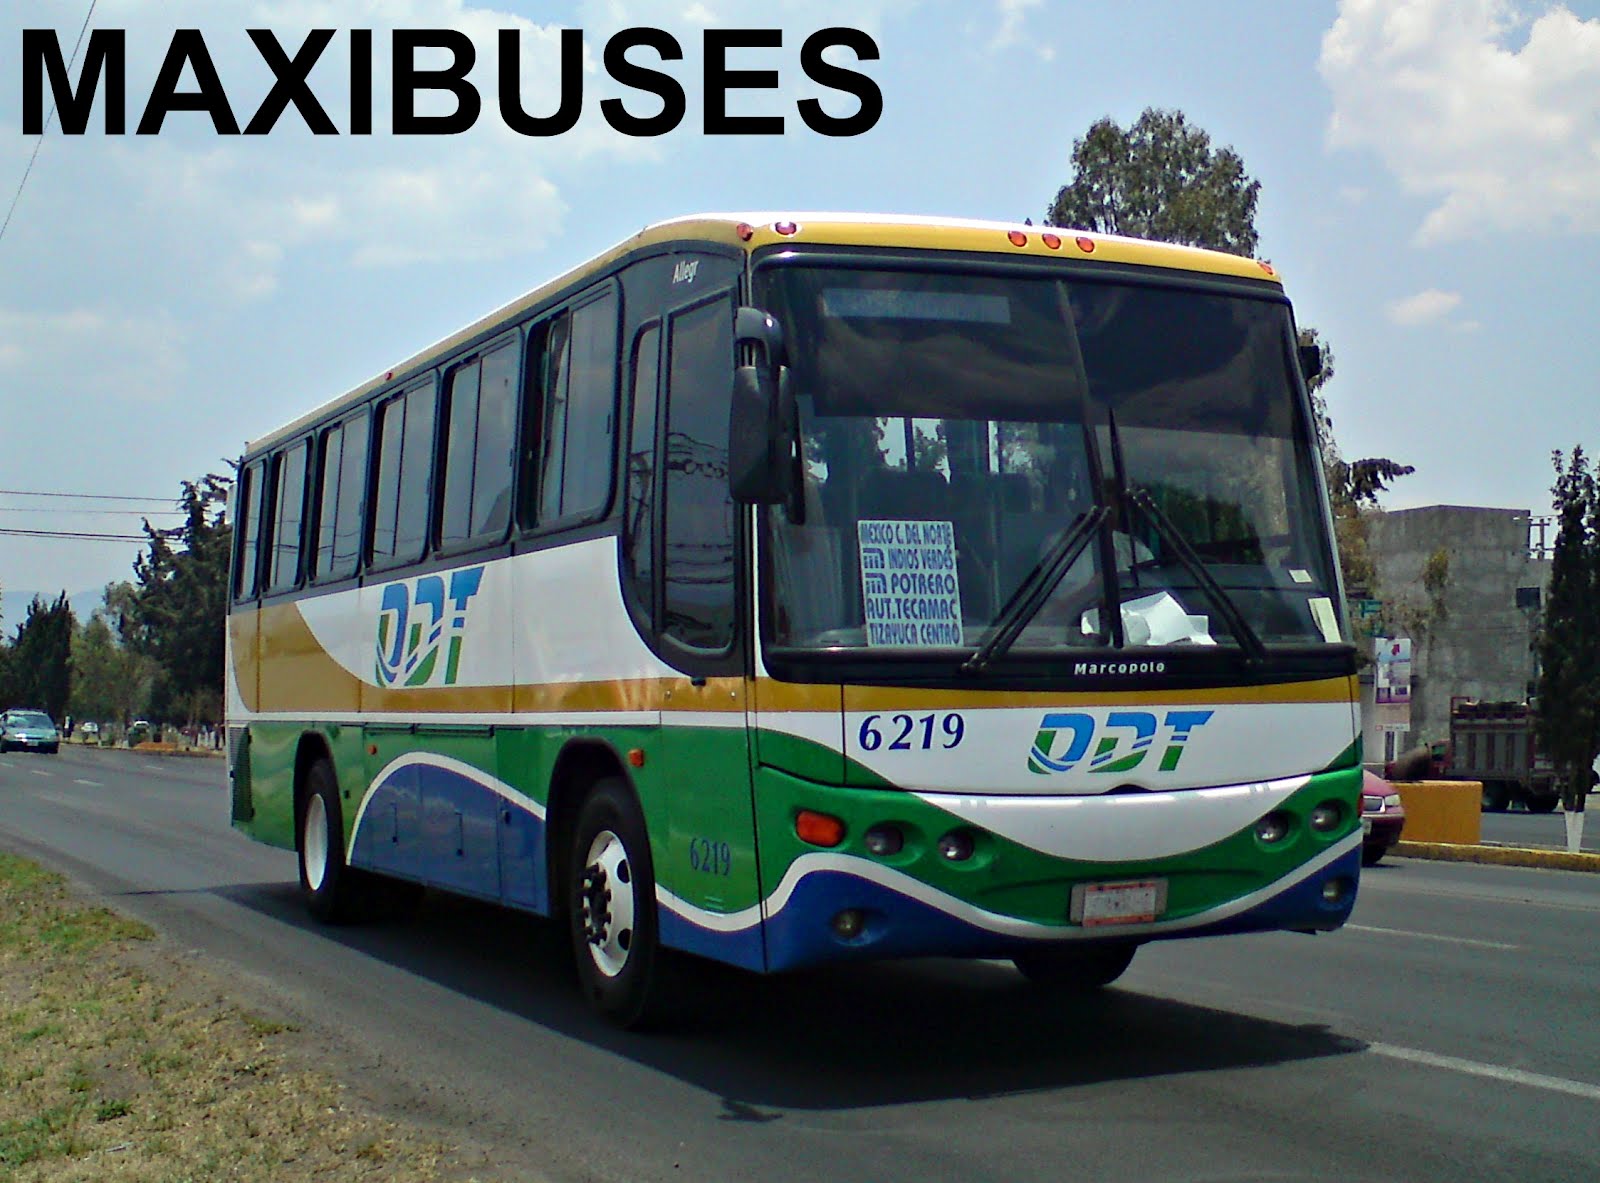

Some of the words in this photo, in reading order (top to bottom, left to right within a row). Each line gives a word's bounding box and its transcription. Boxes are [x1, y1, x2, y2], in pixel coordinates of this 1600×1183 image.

[891, 573, 956, 595] POTRERO
[869, 622, 918, 645] TIZAYUCA
[920, 622, 960, 645] CENTRO
[1074, 661, 1165, 675] Marcopolo
[858, 713, 965, 751] 6219
[690, 837, 731, 876] 6219
